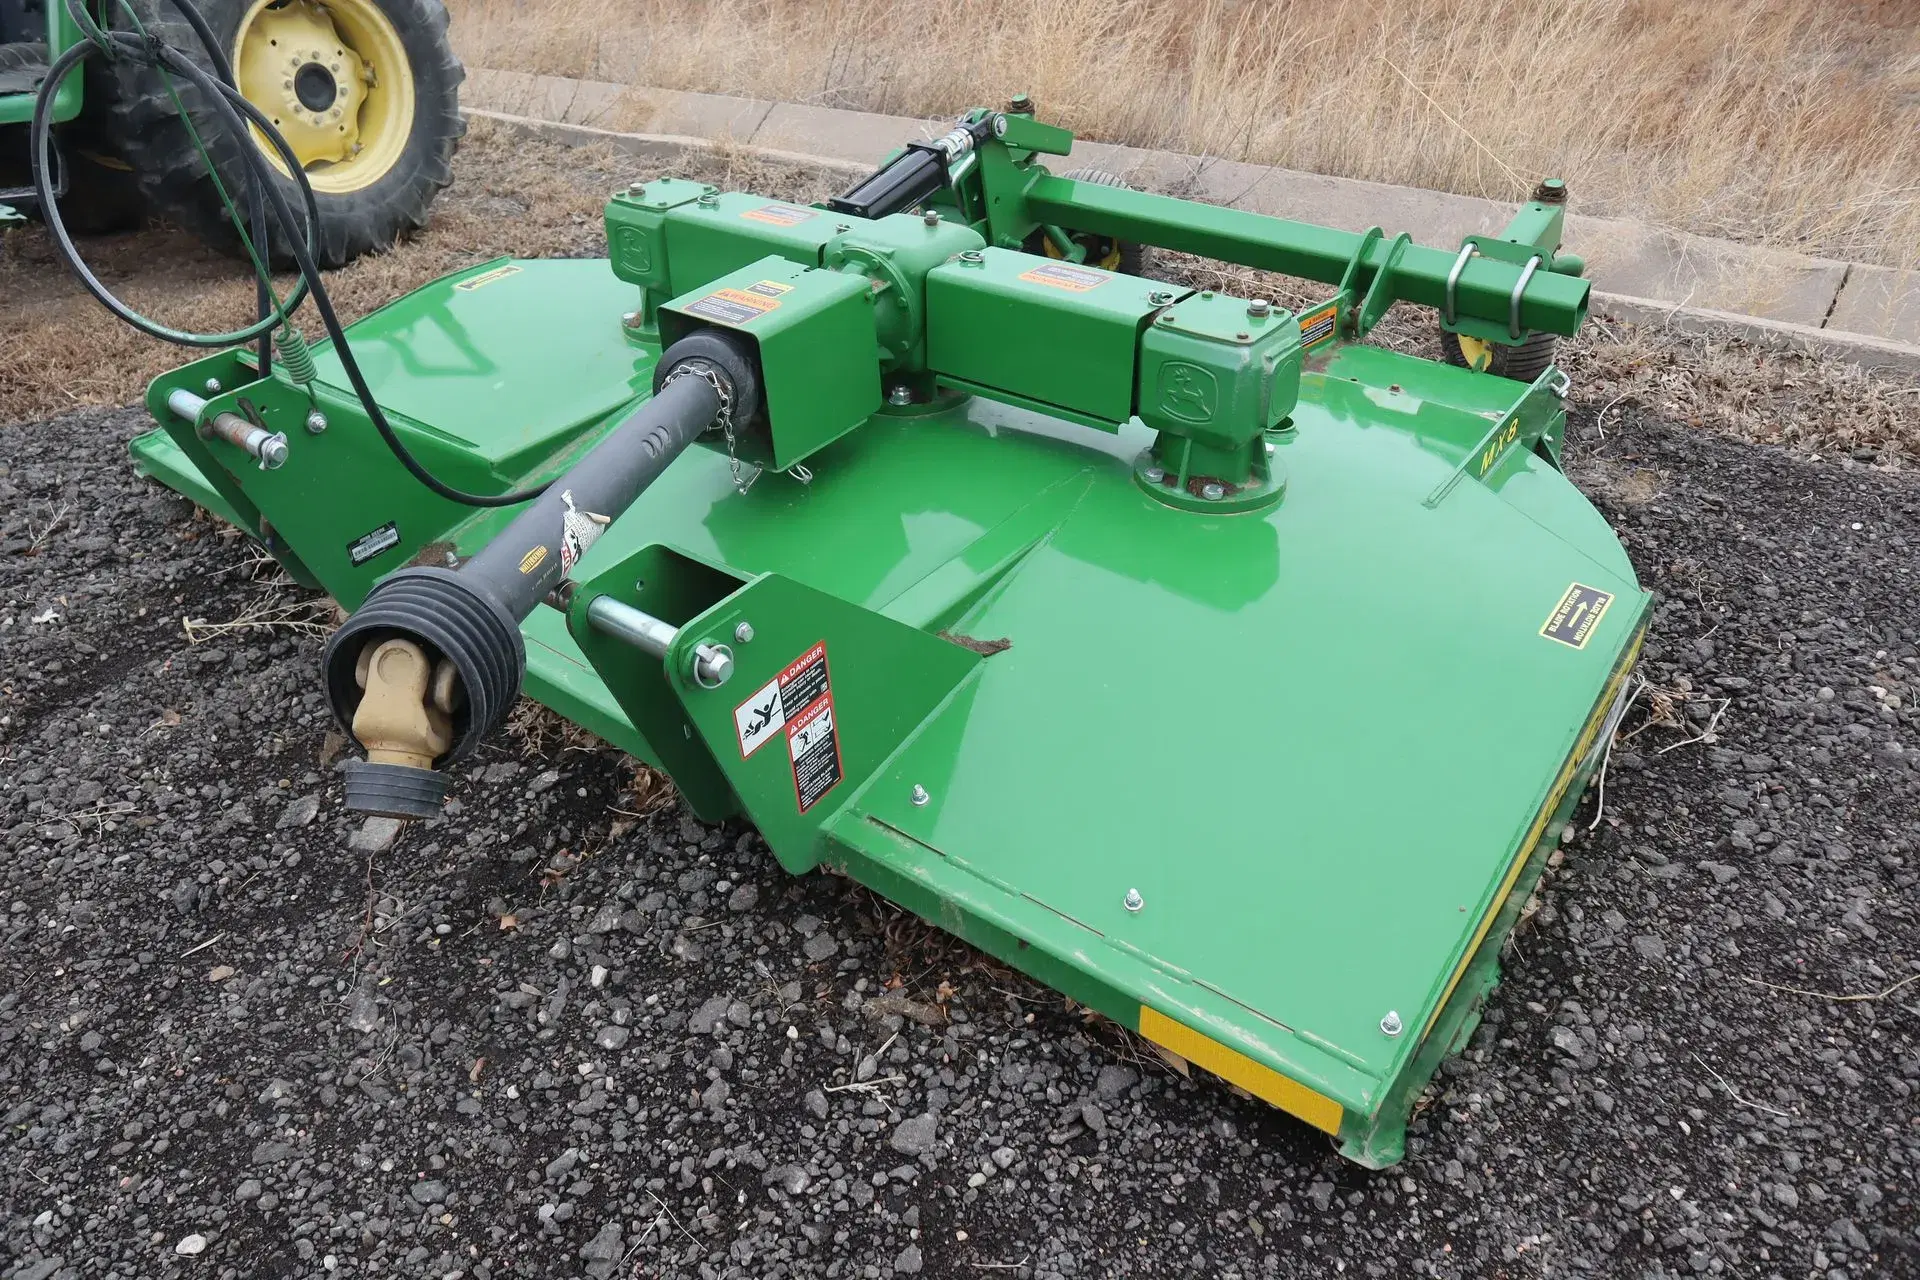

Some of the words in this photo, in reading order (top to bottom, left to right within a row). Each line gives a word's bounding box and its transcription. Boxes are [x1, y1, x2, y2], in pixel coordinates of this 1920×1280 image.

[1548, 612, 1566, 633] BLADE
[1560, 588, 1583, 615] ROTATION
[1589, 596, 1607, 615] BLADE
[1573, 613, 1597, 642] ROTATION
[789, 646, 823, 677] DANGER
[797, 697, 829, 728] DANGER
